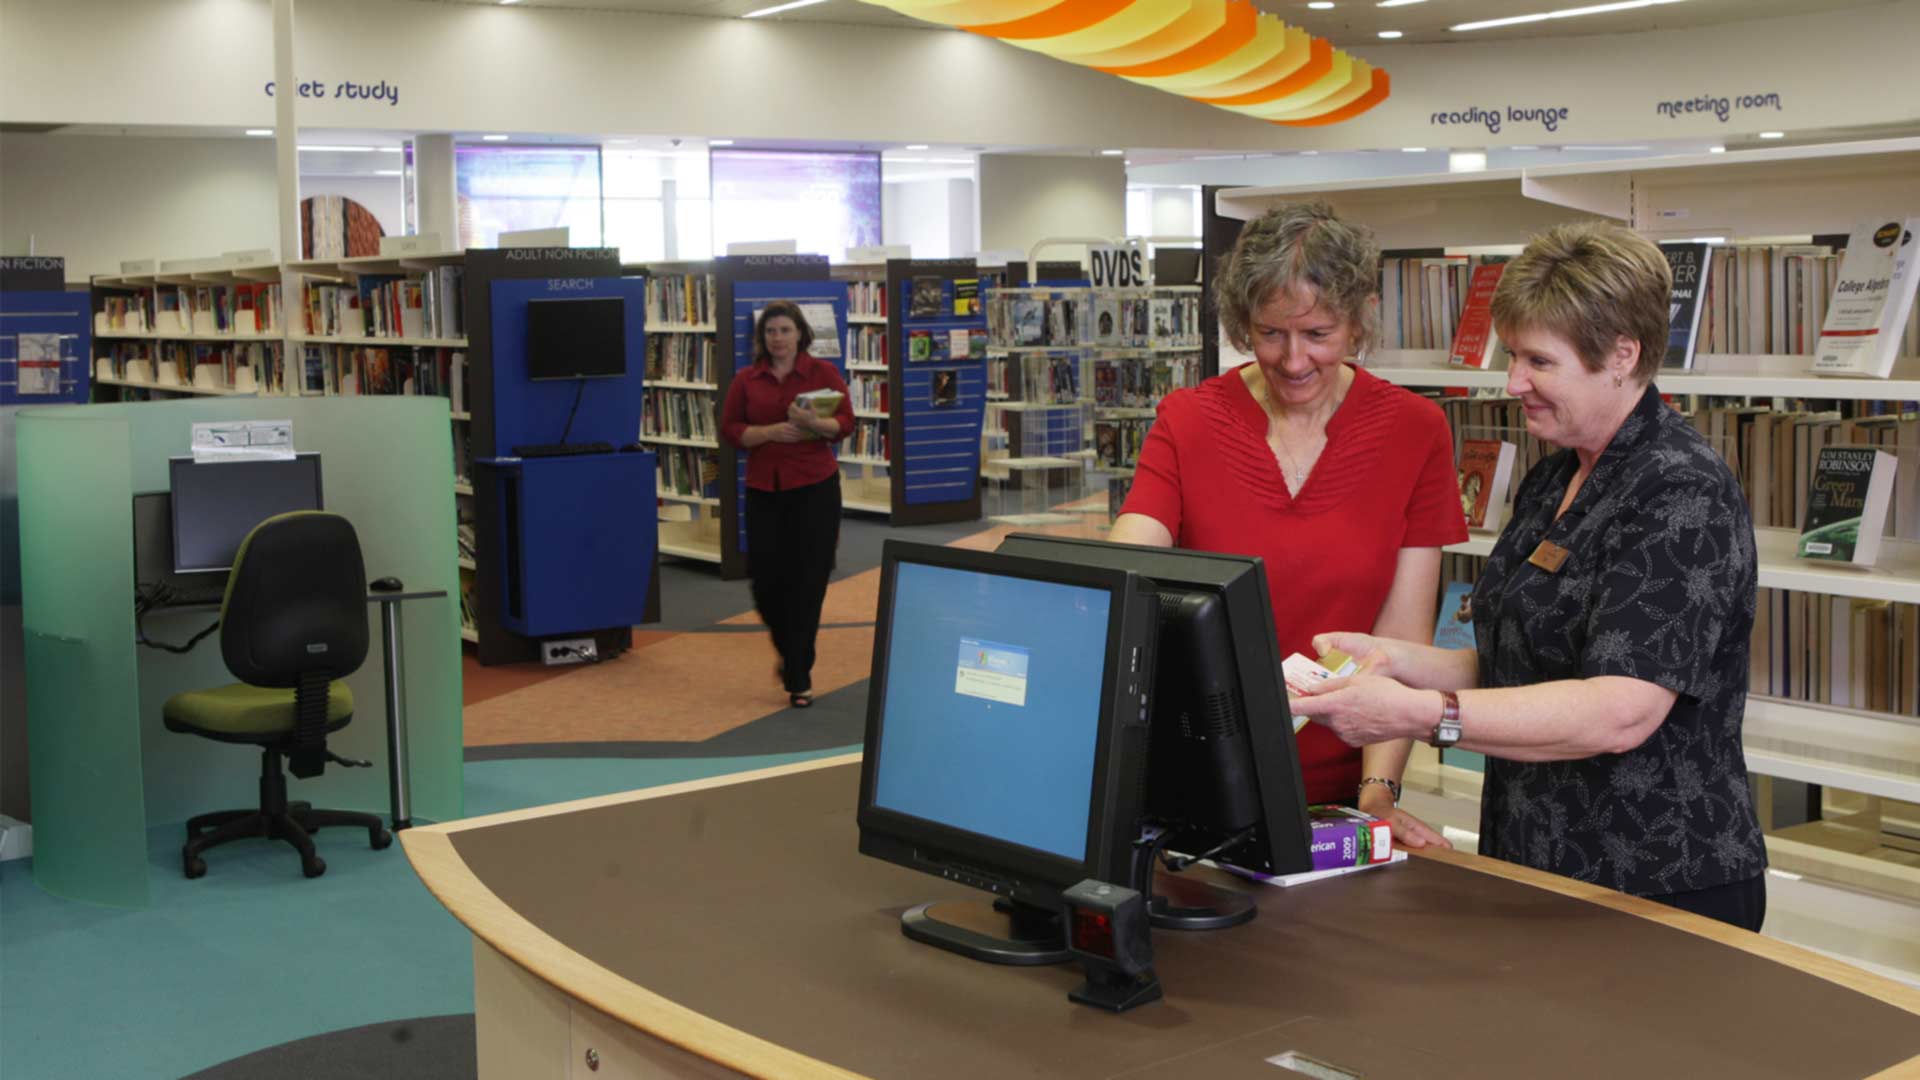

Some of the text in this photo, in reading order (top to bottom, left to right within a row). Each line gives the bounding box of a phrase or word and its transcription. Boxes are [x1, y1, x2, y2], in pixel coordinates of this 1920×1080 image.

[334, 80, 398, 106] study
[1657, 93, 1782, 122] meeting room
[1431, 105, 1569, 134] reading lounge
[506, 248, 619, 260] ADULT NON FICTION
[13, 258, 64, 270] FICTION
[1091, 249, 1144, 287] DVDS
[547, 279, 594, 290] SEARCH
[1821, 450, 1873, 460] KIM STANLEY
[1818, 459, 1873, 472] ROBINSON
[1815, 476, 1856, 492] Green
[1310, 841, 1336, 853] erican
[1342, 836, 1352, 860] 2009
